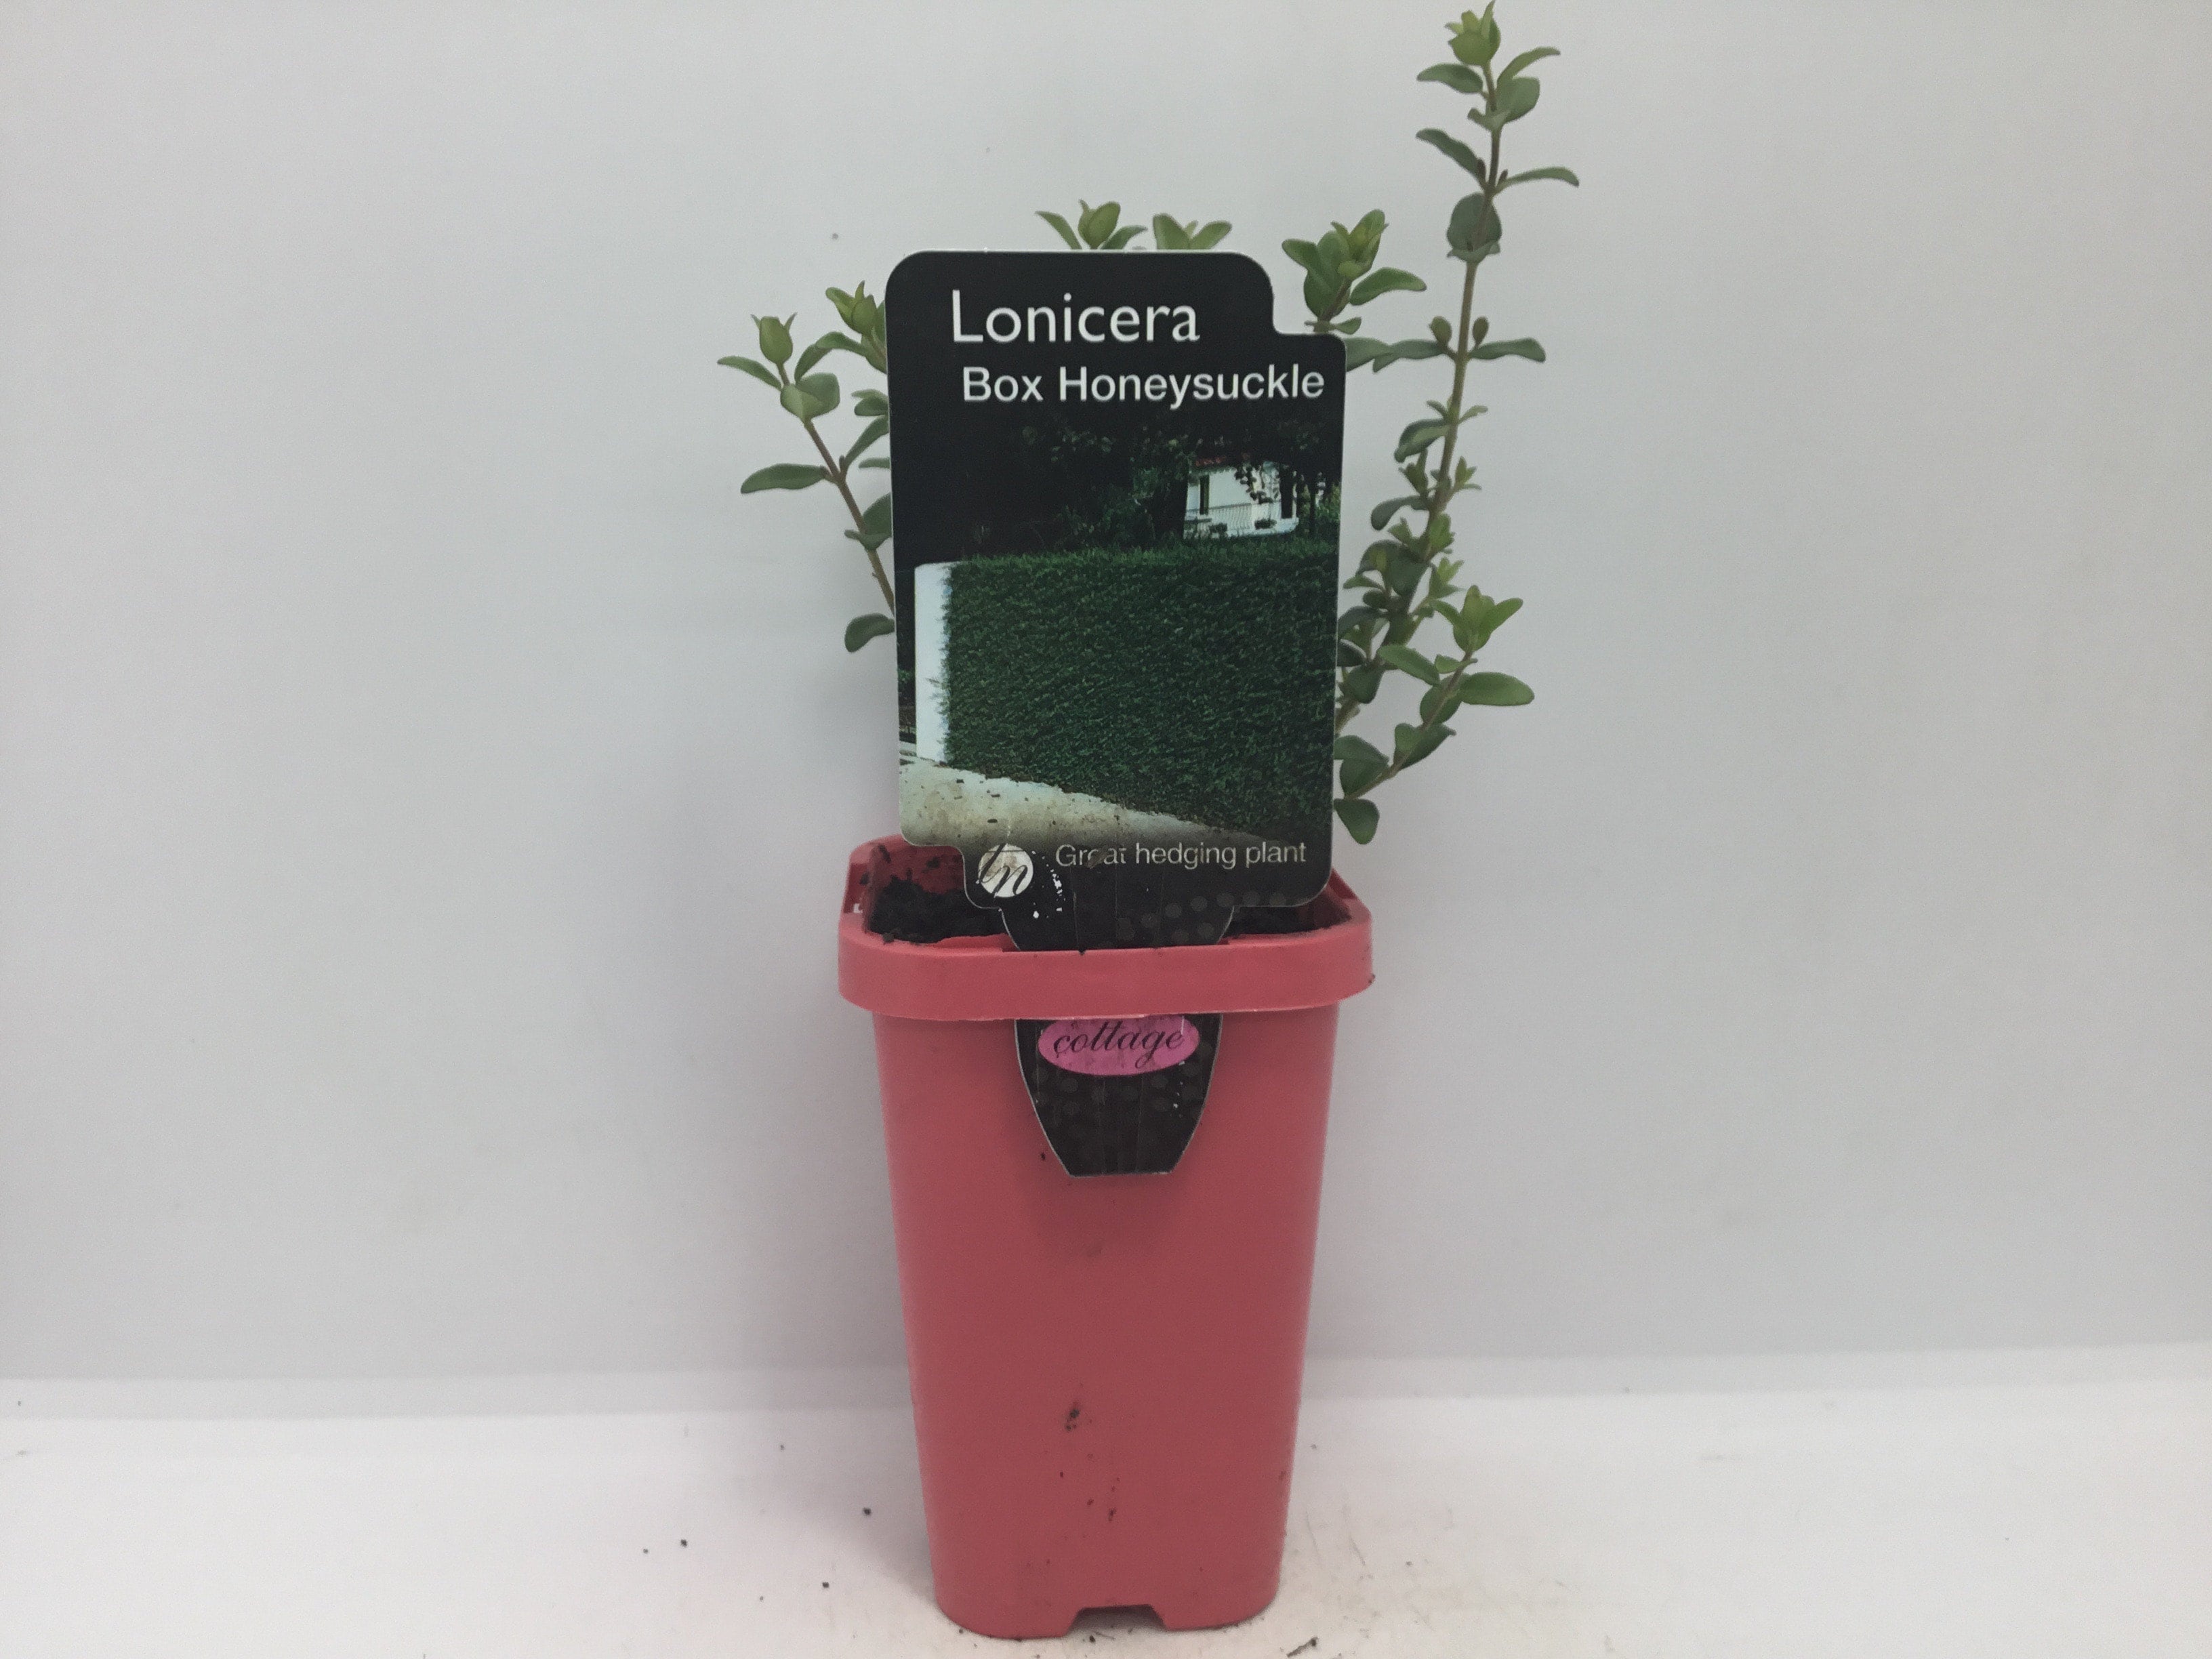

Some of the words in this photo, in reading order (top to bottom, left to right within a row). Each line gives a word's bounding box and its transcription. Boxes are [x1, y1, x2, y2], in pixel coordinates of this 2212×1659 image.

[951, 289, 1200, 342] Lonicera
[962, 366, 1044, 401] Box
[1059, 364, 1325, 410] Honeysuckle
[1135, 842, 1236, 870] hedging
[1245, 841, 1307, 869] plant
[1053, 1020, 1184, 1069] cottage
